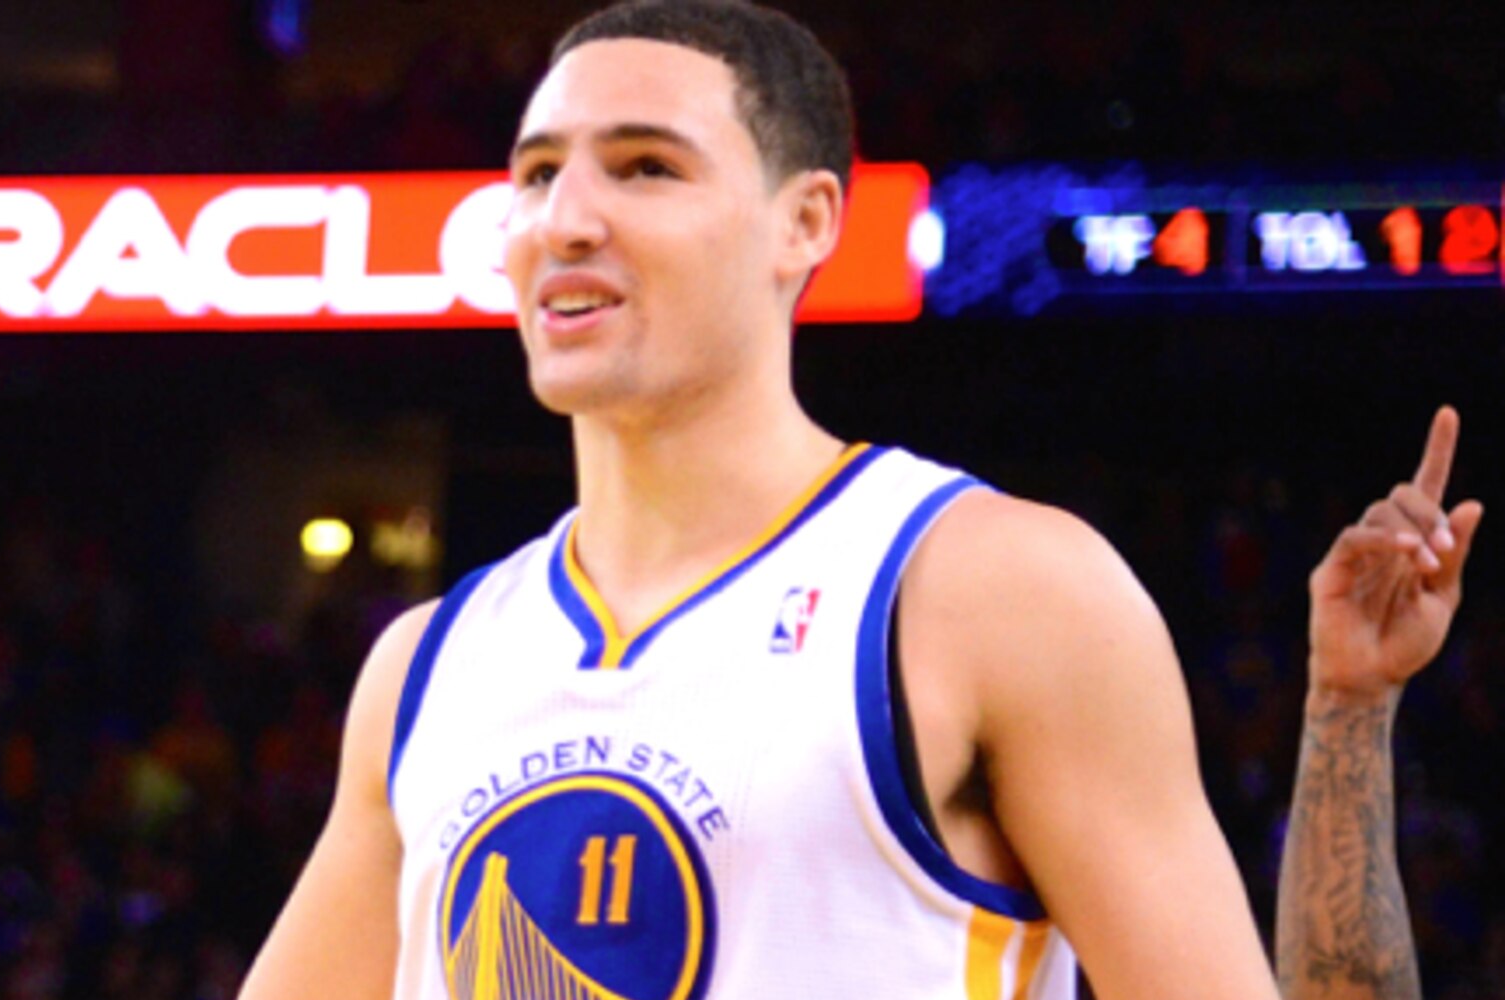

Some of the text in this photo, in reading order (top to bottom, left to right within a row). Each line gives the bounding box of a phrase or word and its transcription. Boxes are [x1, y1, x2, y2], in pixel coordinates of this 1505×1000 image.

[1152, 207, 1209, 276] 4
[1380, 205, 1423, 276] 1
[438, 734, 730, 850] GOLDEN STATE
[576, 834, 637, 925] 11
